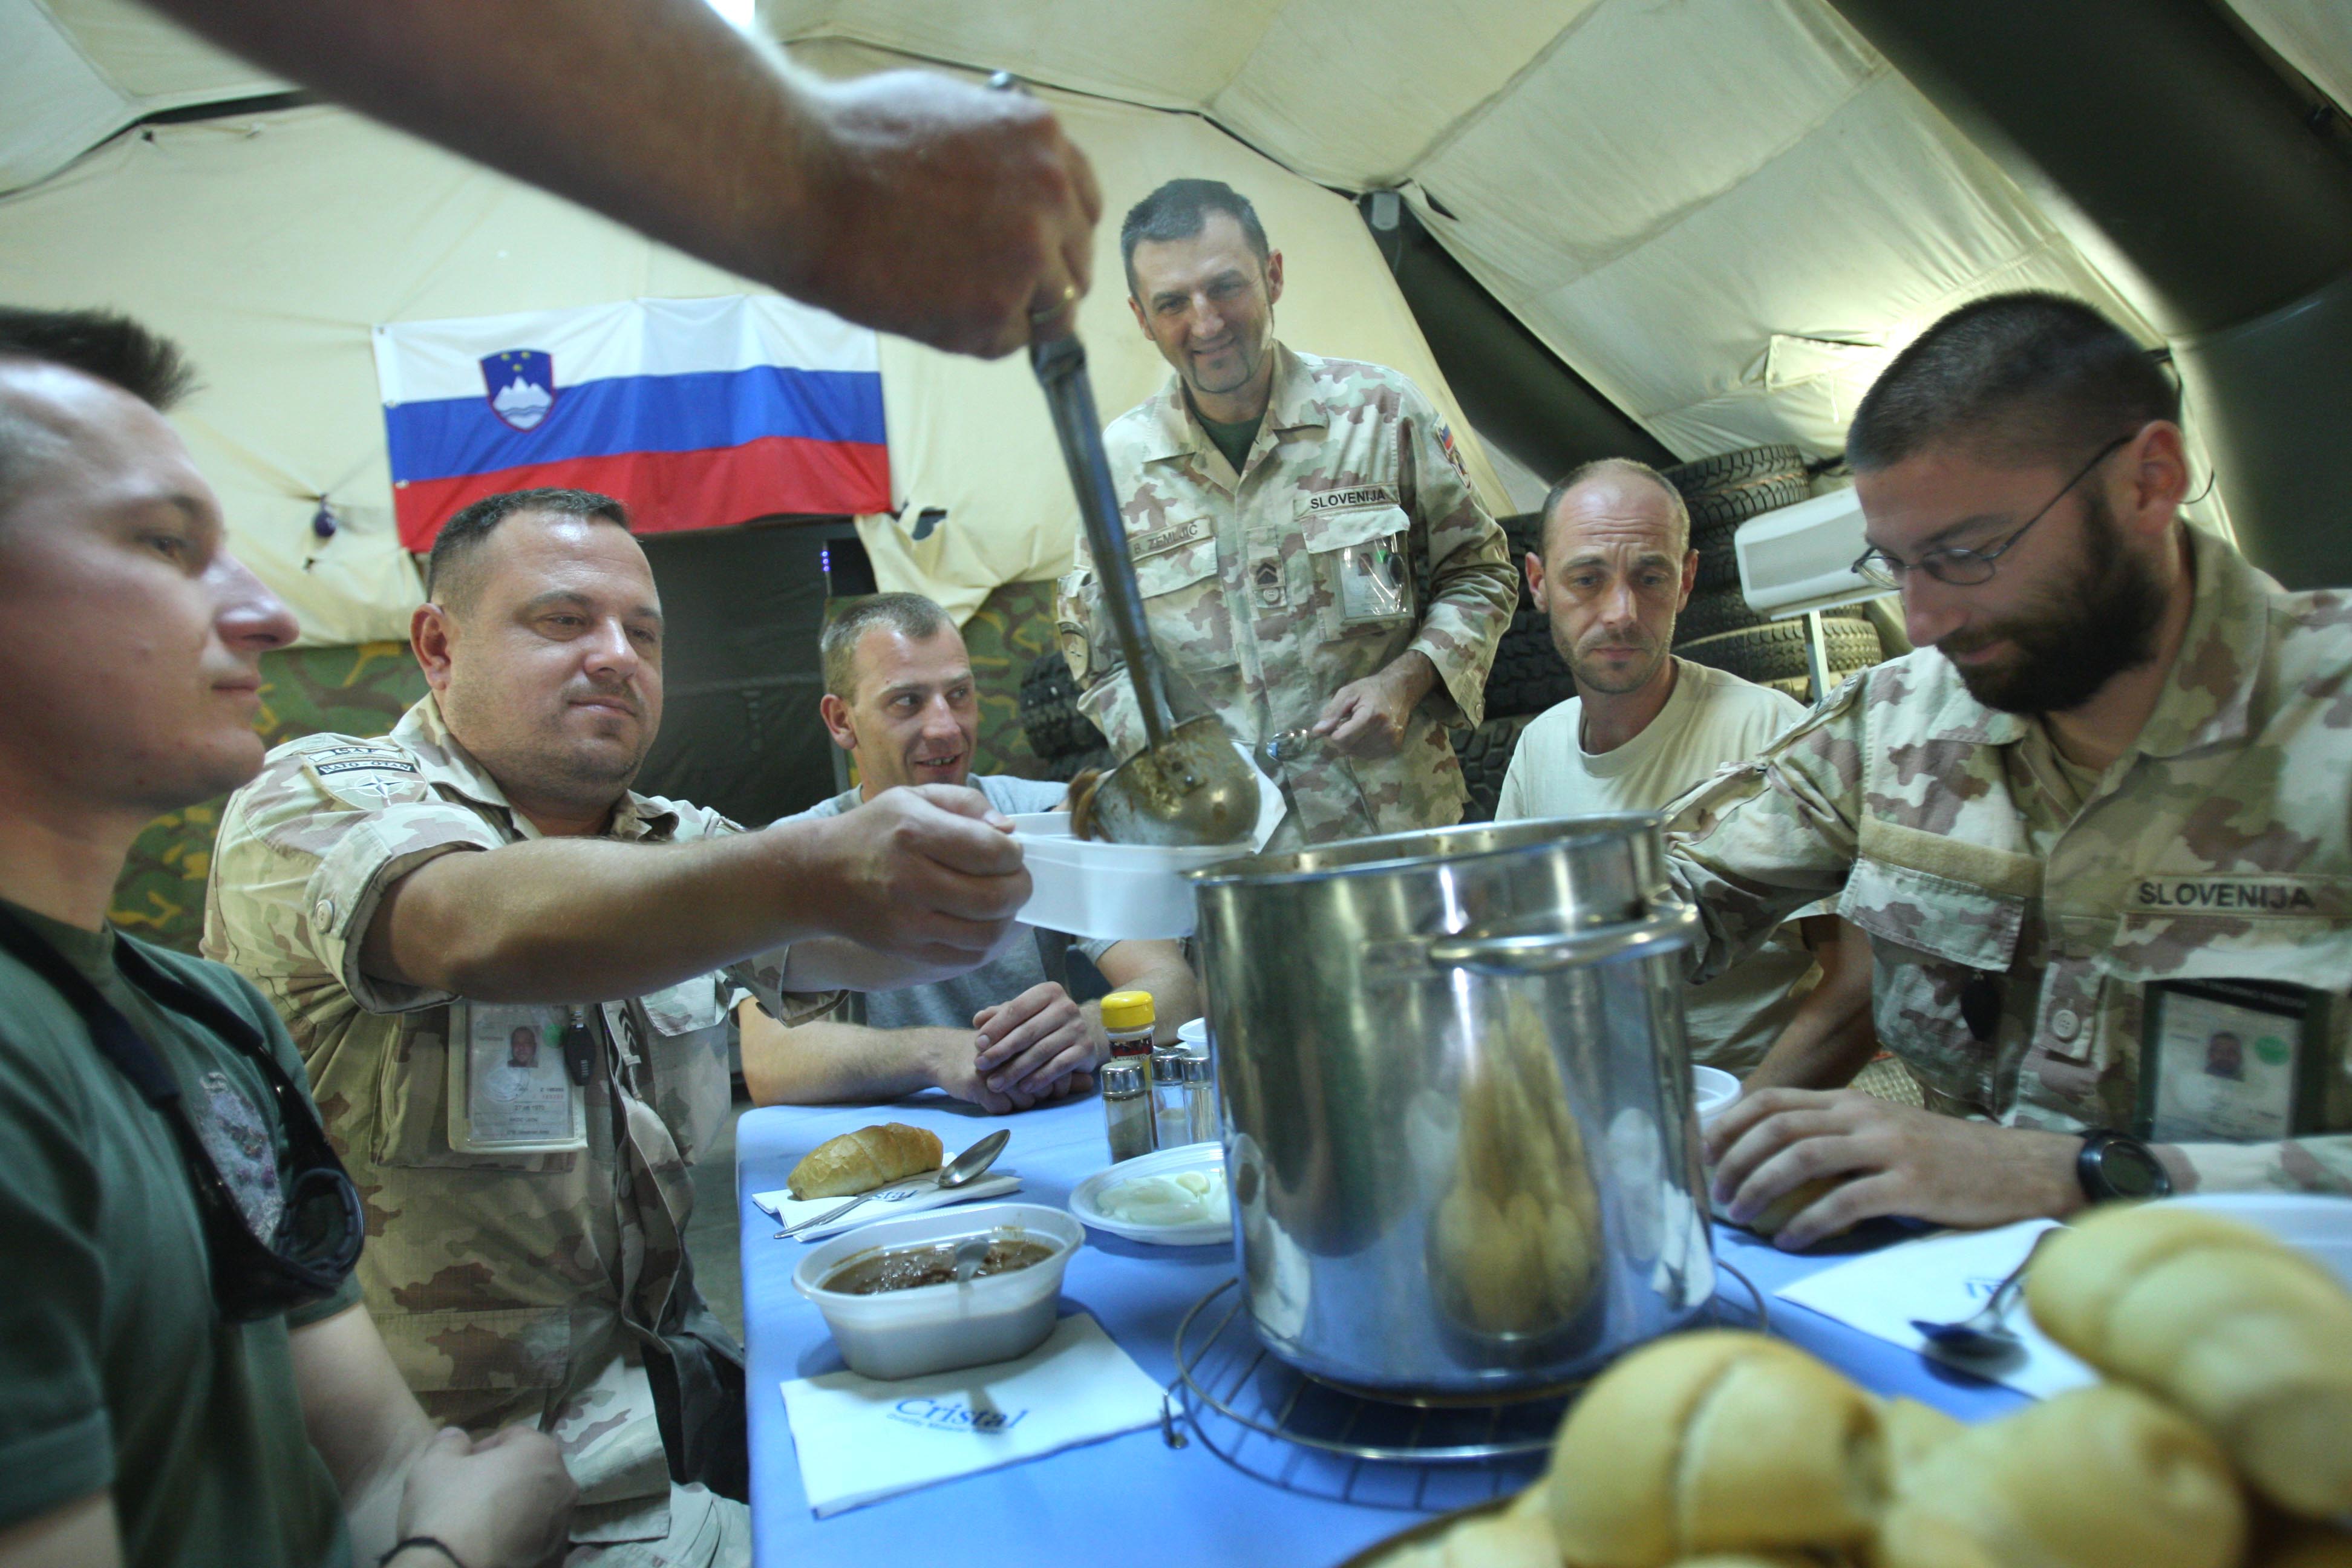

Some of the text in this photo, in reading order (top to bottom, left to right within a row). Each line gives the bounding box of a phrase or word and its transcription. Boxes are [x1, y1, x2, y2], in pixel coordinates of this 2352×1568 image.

[1311, 489, 1385, 509] SLOVENIJA
[321, 763, 358, 772] NATO
[371, 761, 411, 769] OTAN
[2139, 881, 2315, 908] SLOVENIJA
[896, 1398, 1028, 1428] Cristal
